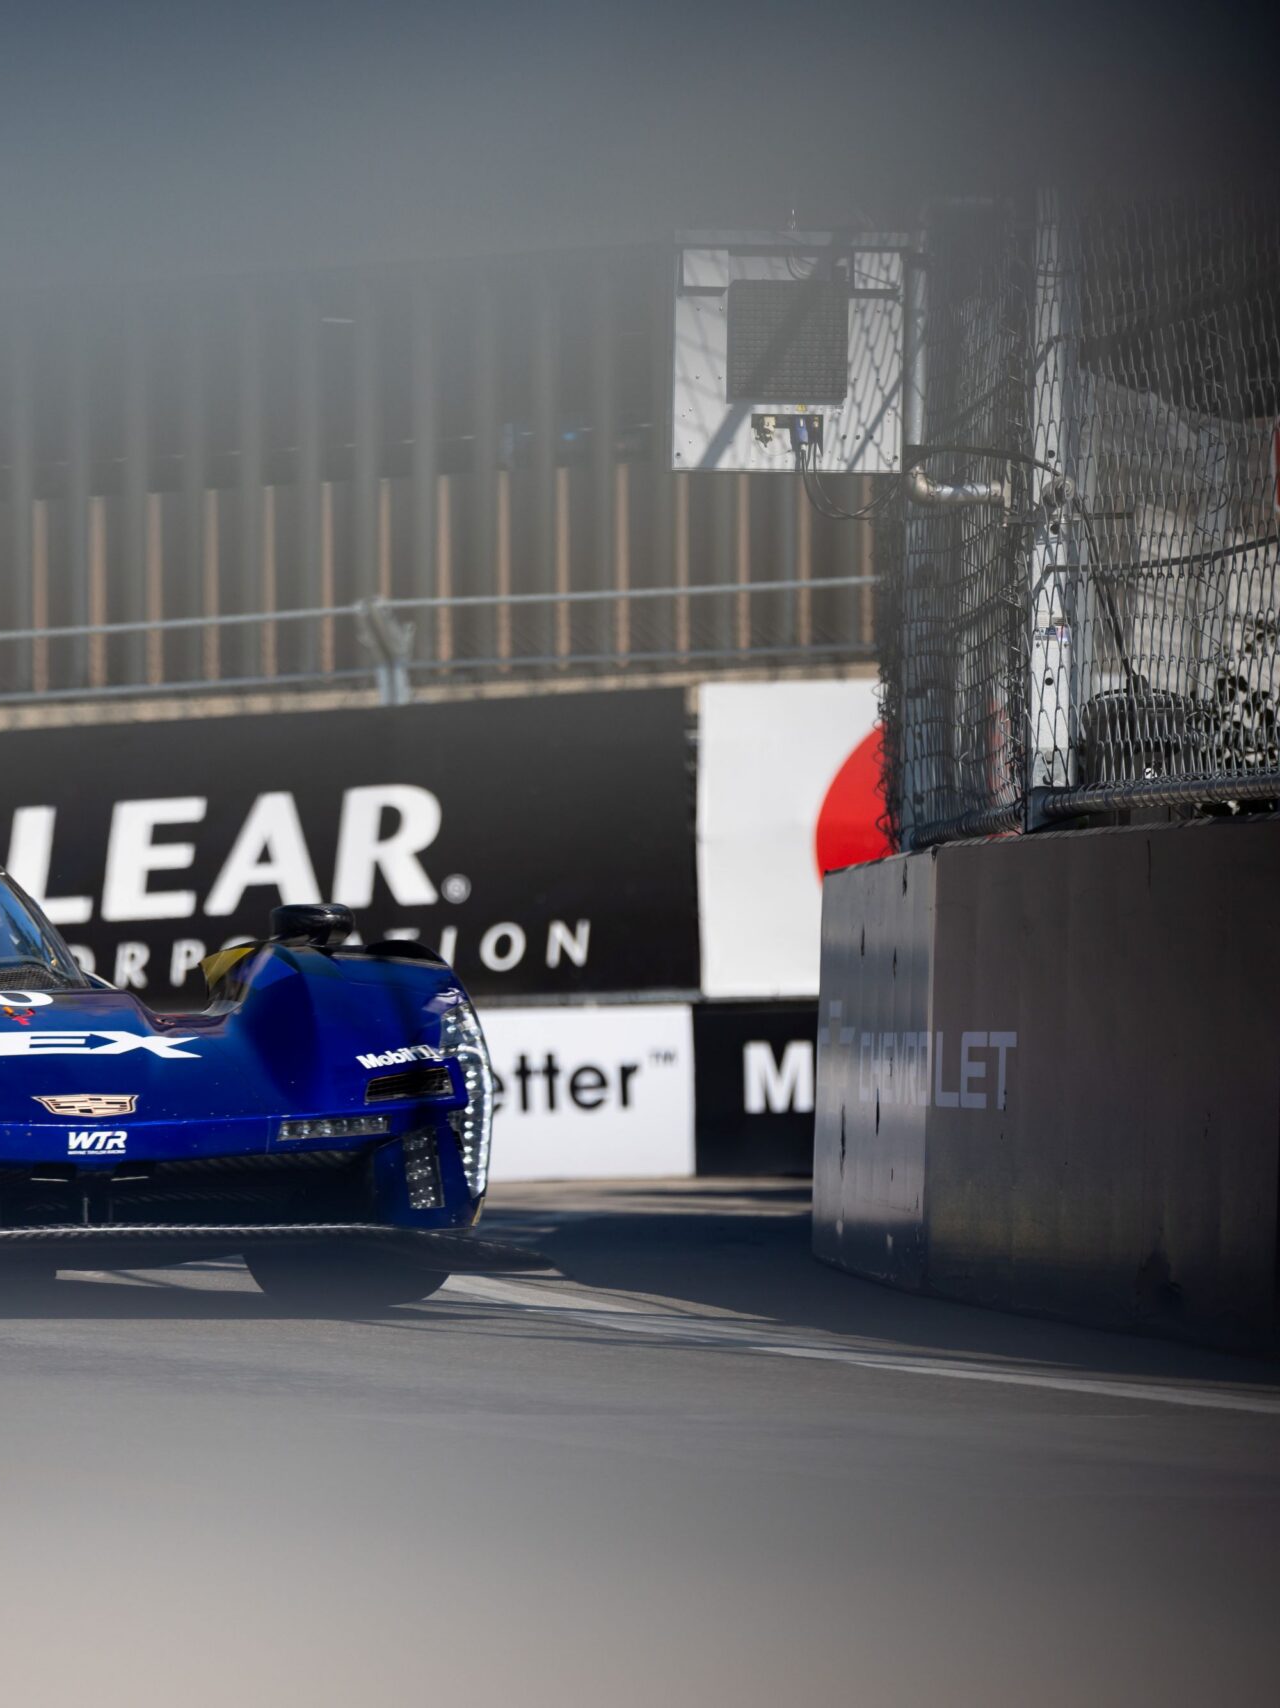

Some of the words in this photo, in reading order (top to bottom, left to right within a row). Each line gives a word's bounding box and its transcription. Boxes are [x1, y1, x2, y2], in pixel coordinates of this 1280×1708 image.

[356, 1047, 418, 1069] Mobil
[859, 1031, 1018, 1110] CHEVROLET
[68, 1131, 128, 1150] WTR
